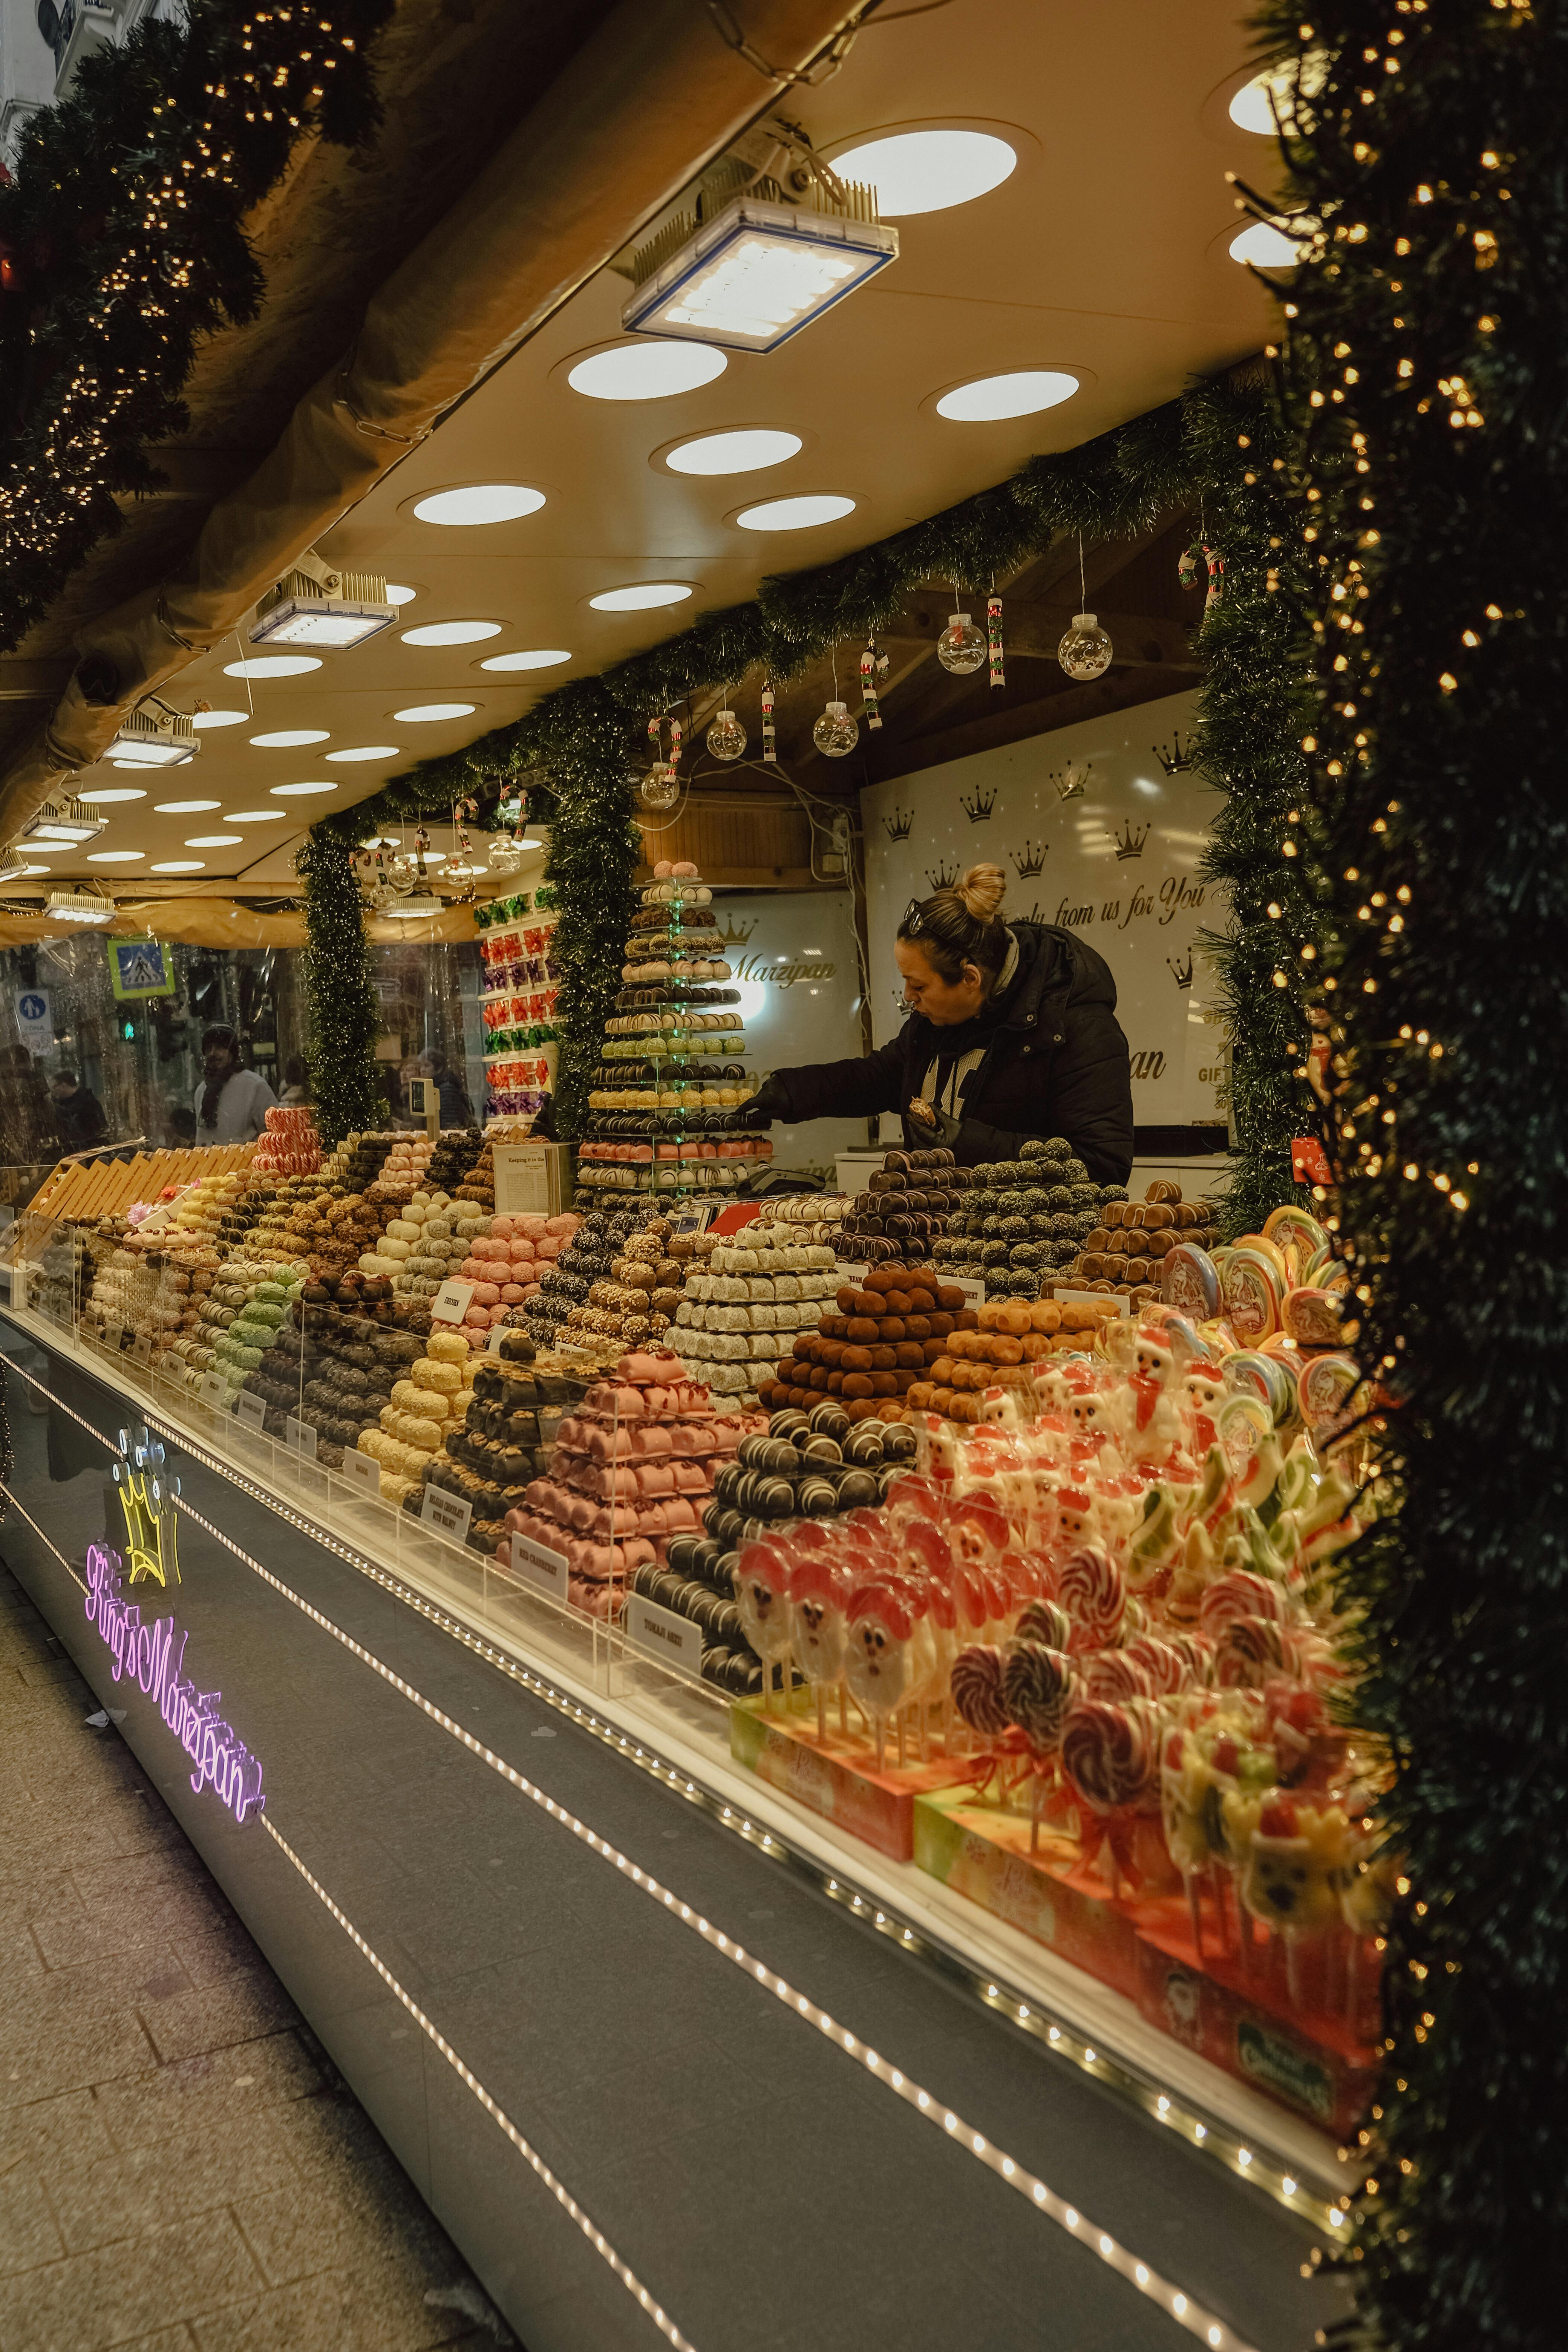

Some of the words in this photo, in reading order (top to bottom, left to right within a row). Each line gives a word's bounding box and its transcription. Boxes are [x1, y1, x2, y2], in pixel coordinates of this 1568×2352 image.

[1055, 897, 1094, 927] from
[1101, 900, 1120, 922] us
[1118, 885, 1155, 930] for
[1158, 877, 1207, 925] You
[728, 953, 836, 989] Marzipan
[444, 1297, 460, 1307] UNICORN
[429, 1493, 444, 1509] BELGIAN
[444, 1501, 464, 1520] CHOCOLATE
[433, 1510, 443, 1523] WITH
[519, 1548, 528, 1560] RED
[529, 1553, 557, 1576] CRANBERRY
